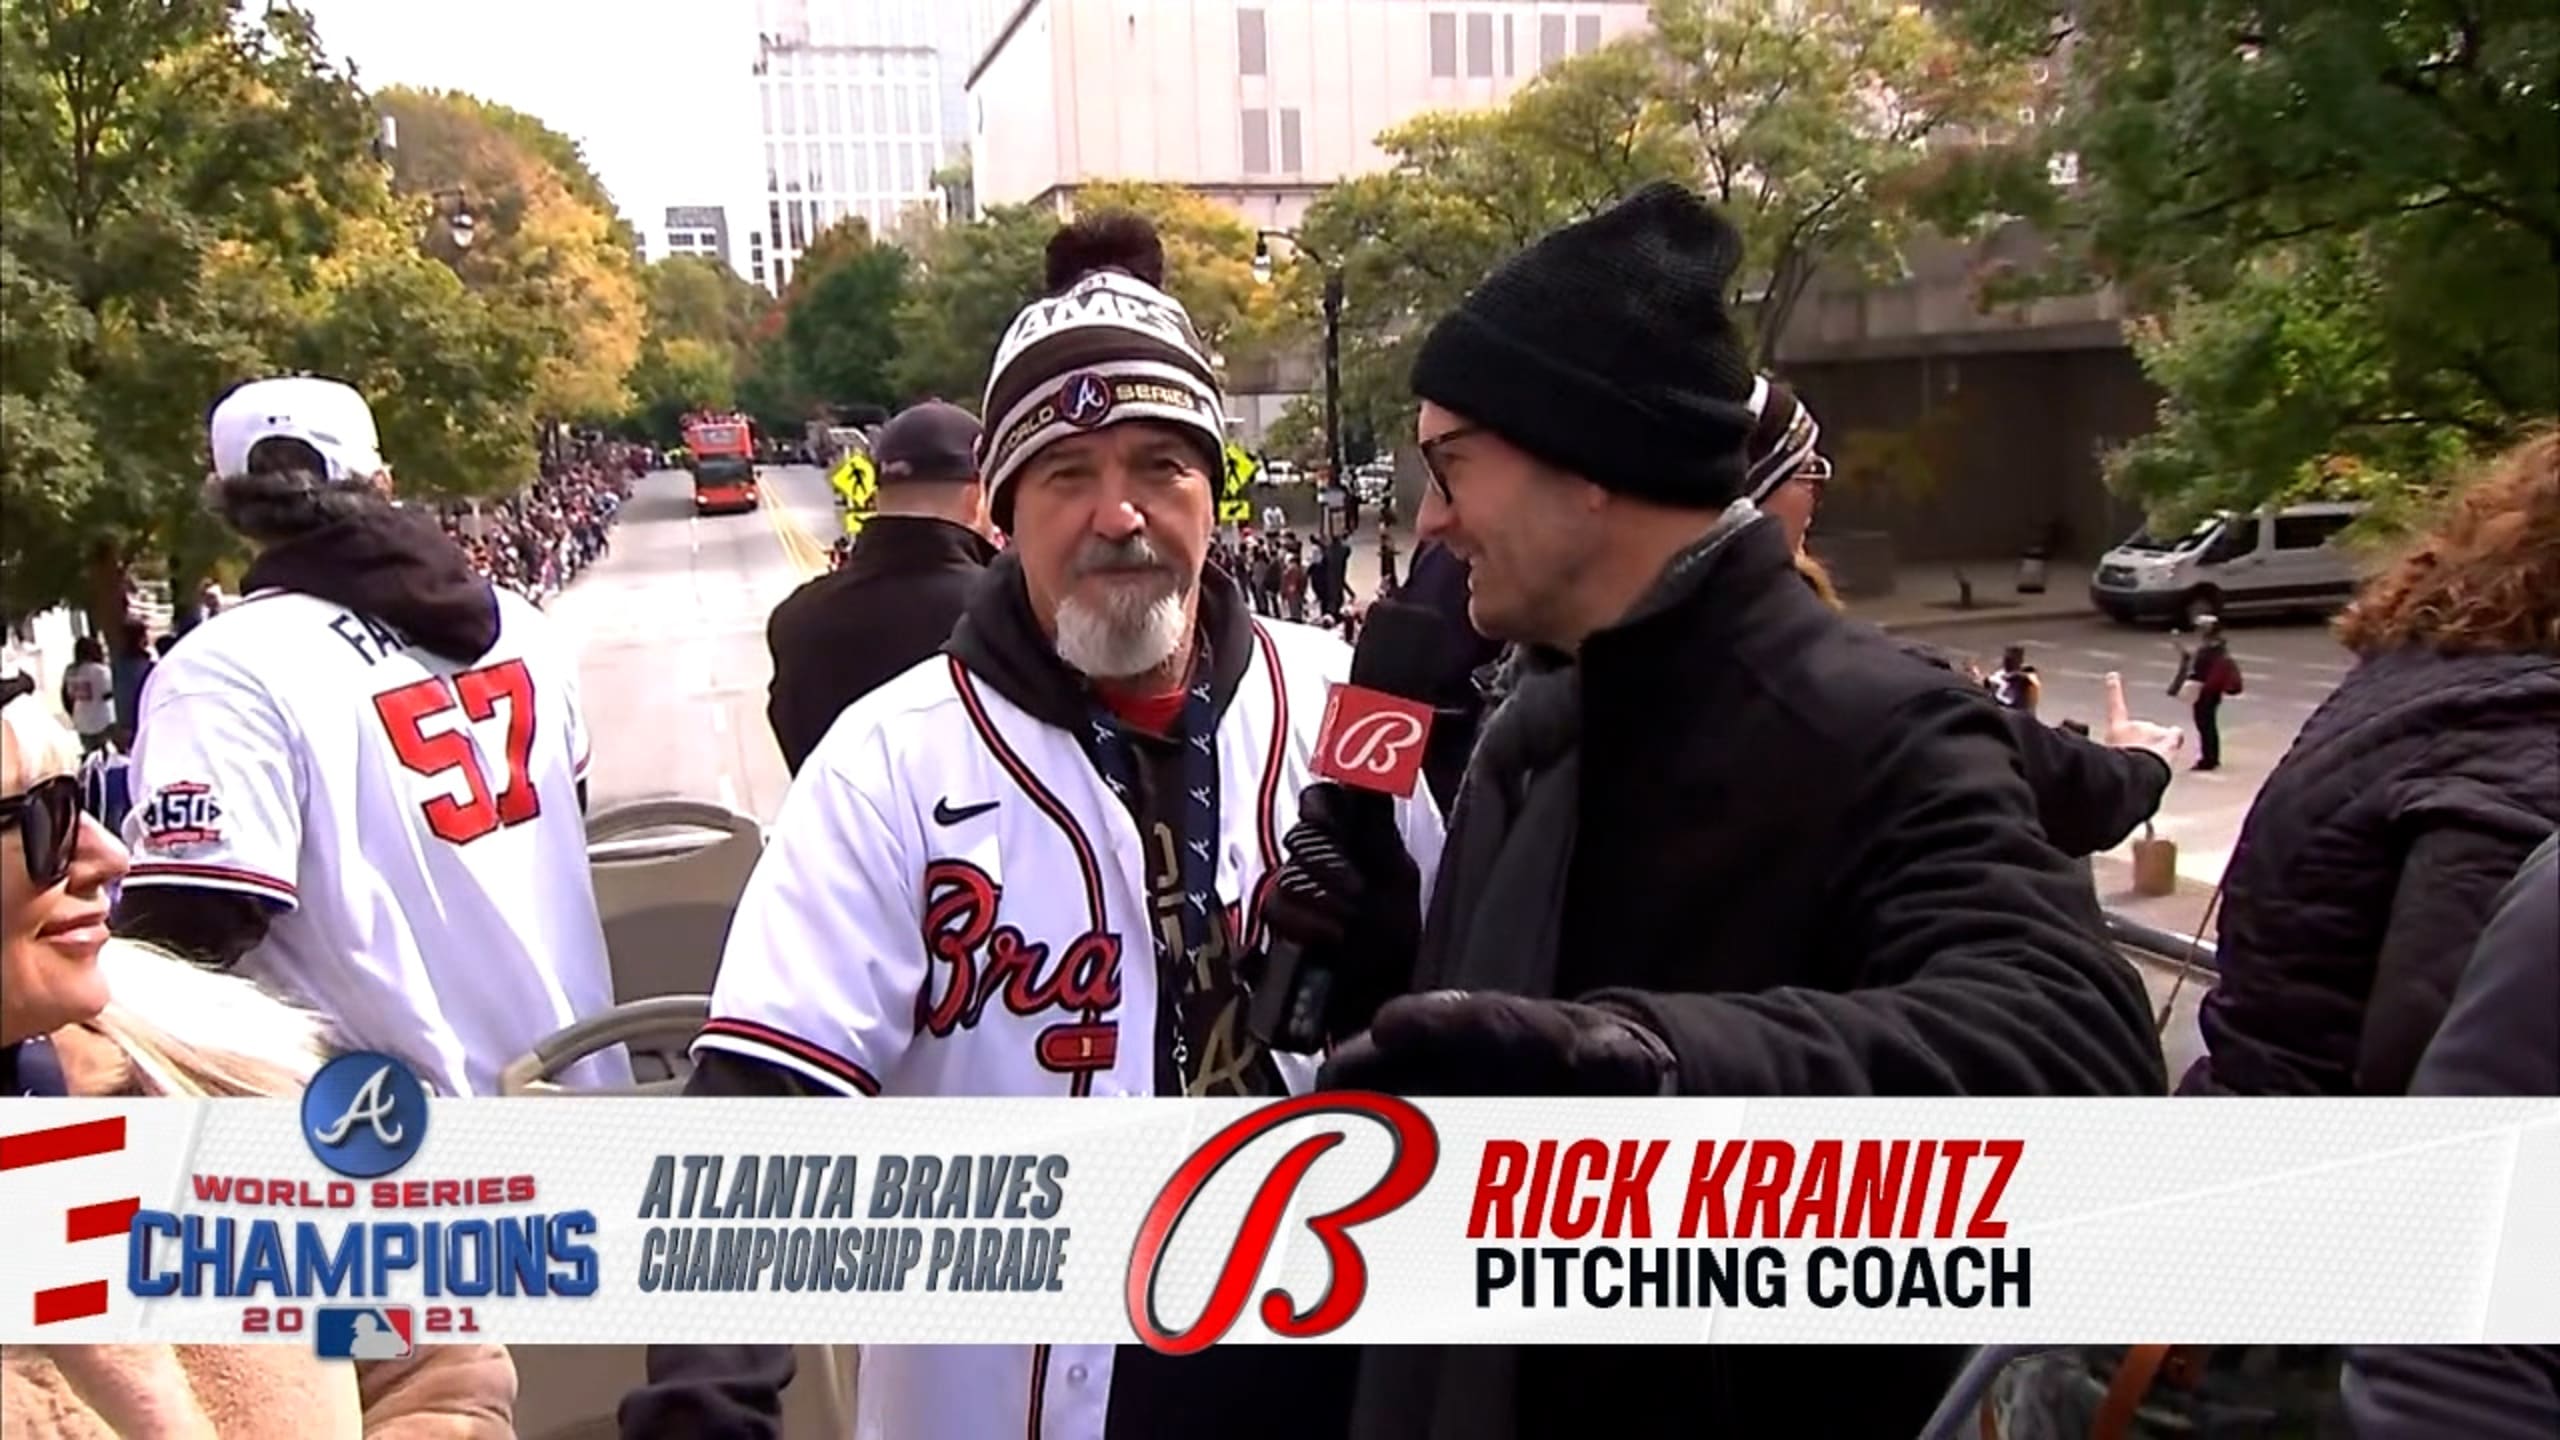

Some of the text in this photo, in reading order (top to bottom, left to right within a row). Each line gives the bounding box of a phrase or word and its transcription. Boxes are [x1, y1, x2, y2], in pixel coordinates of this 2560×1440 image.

[1012, 290, 1186, 342] AMPS
[1115, 383, 1195, 410] SERIES
[328, 606, 402, 666] FA
[372, 658, 541, 846] 57
[1335, 711, 1422, 773] B
[914, 858, 1122, 1037] Bra
